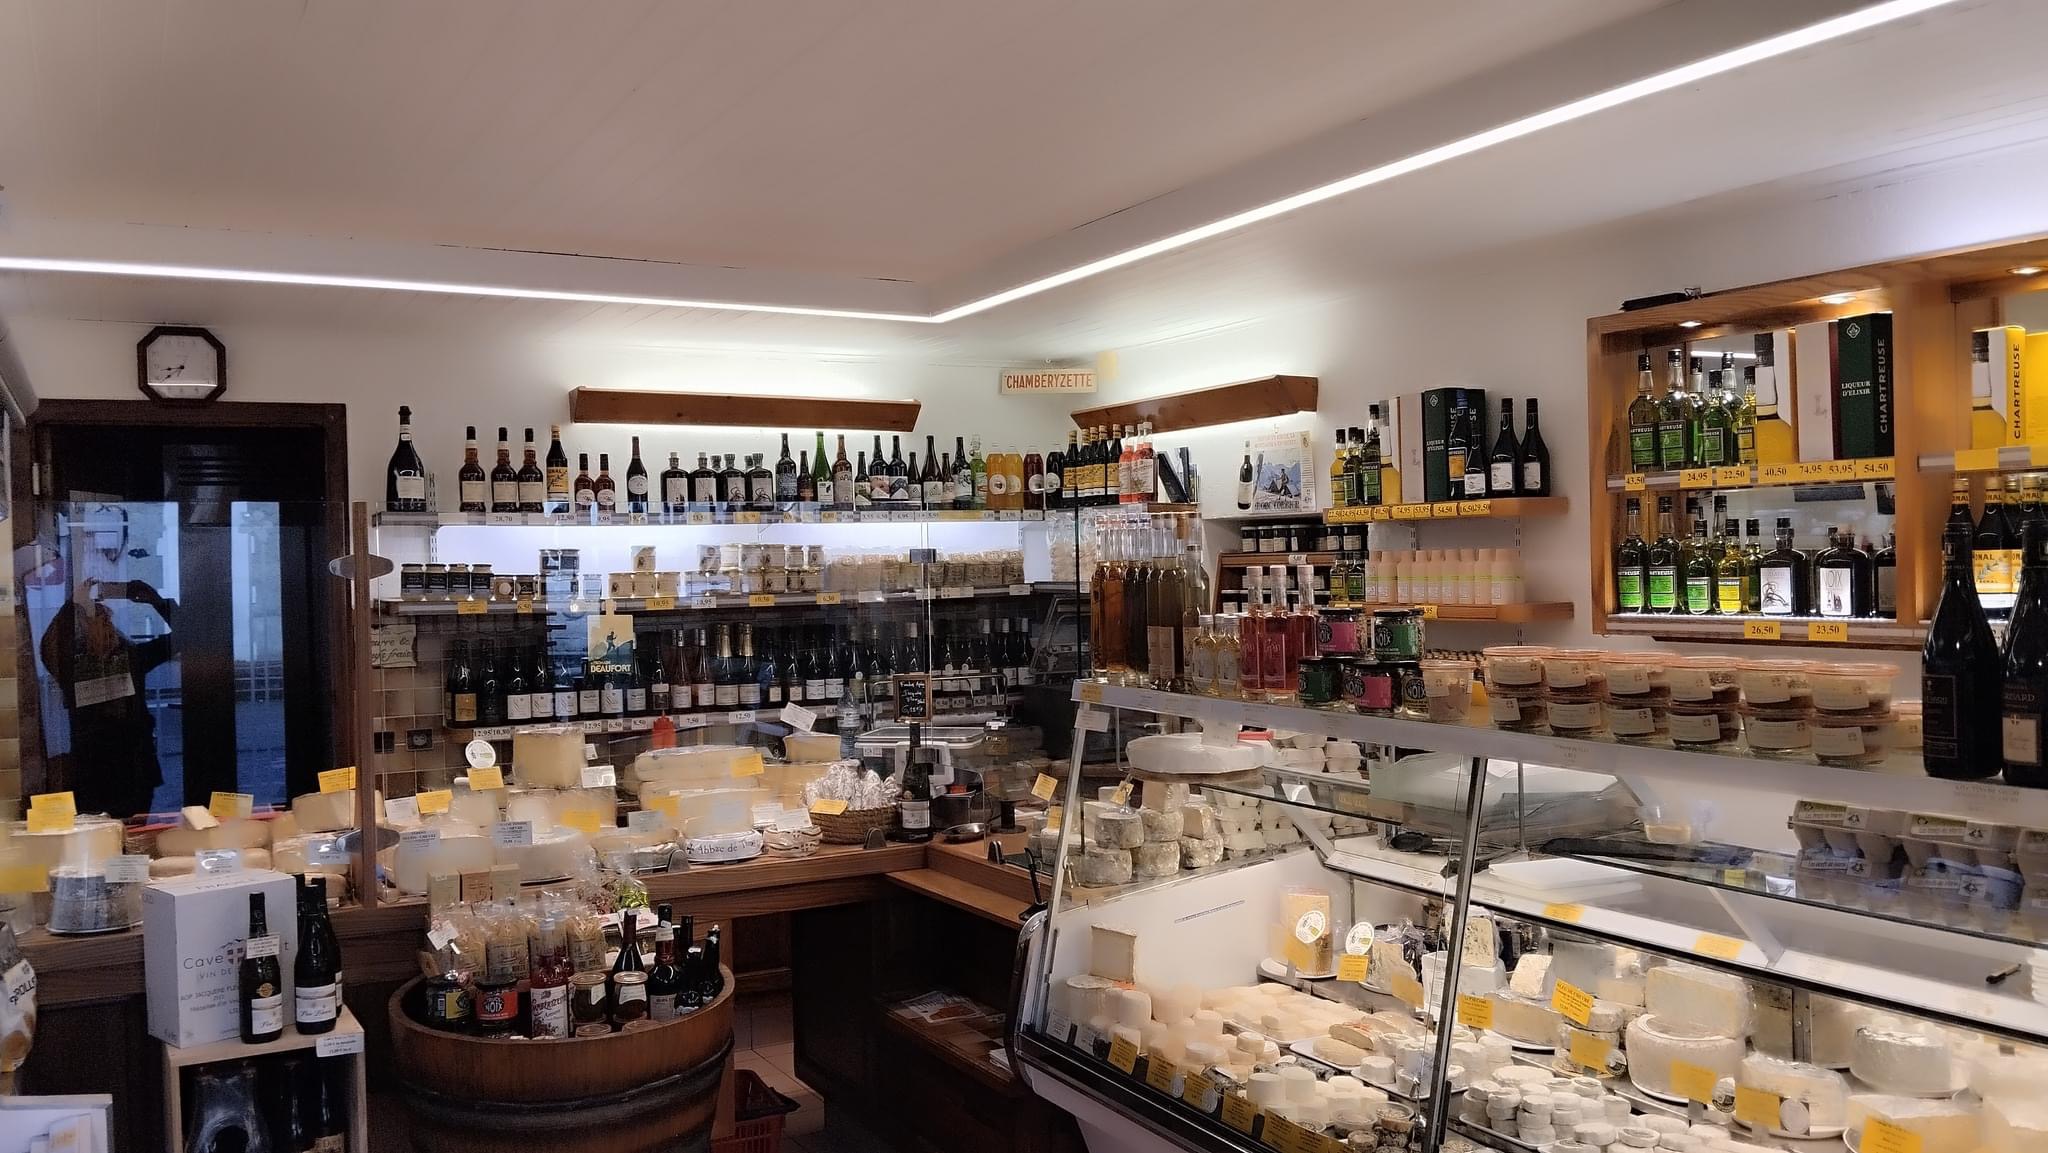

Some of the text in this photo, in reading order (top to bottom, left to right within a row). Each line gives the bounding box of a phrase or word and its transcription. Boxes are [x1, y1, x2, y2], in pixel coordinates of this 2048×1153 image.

[1006, 373, 1093, 389] CHAMBERYZETTE
[1841, 381, 1871, 390] LIQUEUR
[1877, 338, 1888, 434] CHARTREUSE
[2013, 343, 2021, 439] CHARTREUSE
[1764, 467, 1787, 477] 40.50
[1800, 465, 1822, 474] 74.95
[1829, 464, 1853, 474] 53.95
[1863, 463, 1889, 473] 54.50
[1687, 472, 1708, 482] 24.95
[1723, 470, 1745, 480] 22.50
[1626, 476, 1645, 485] 43.50
[1751, 625, 1774, 635] 26.50
[1816, 625, 1840, 634] 23.50
[183, 955, 224, 970] Cave
